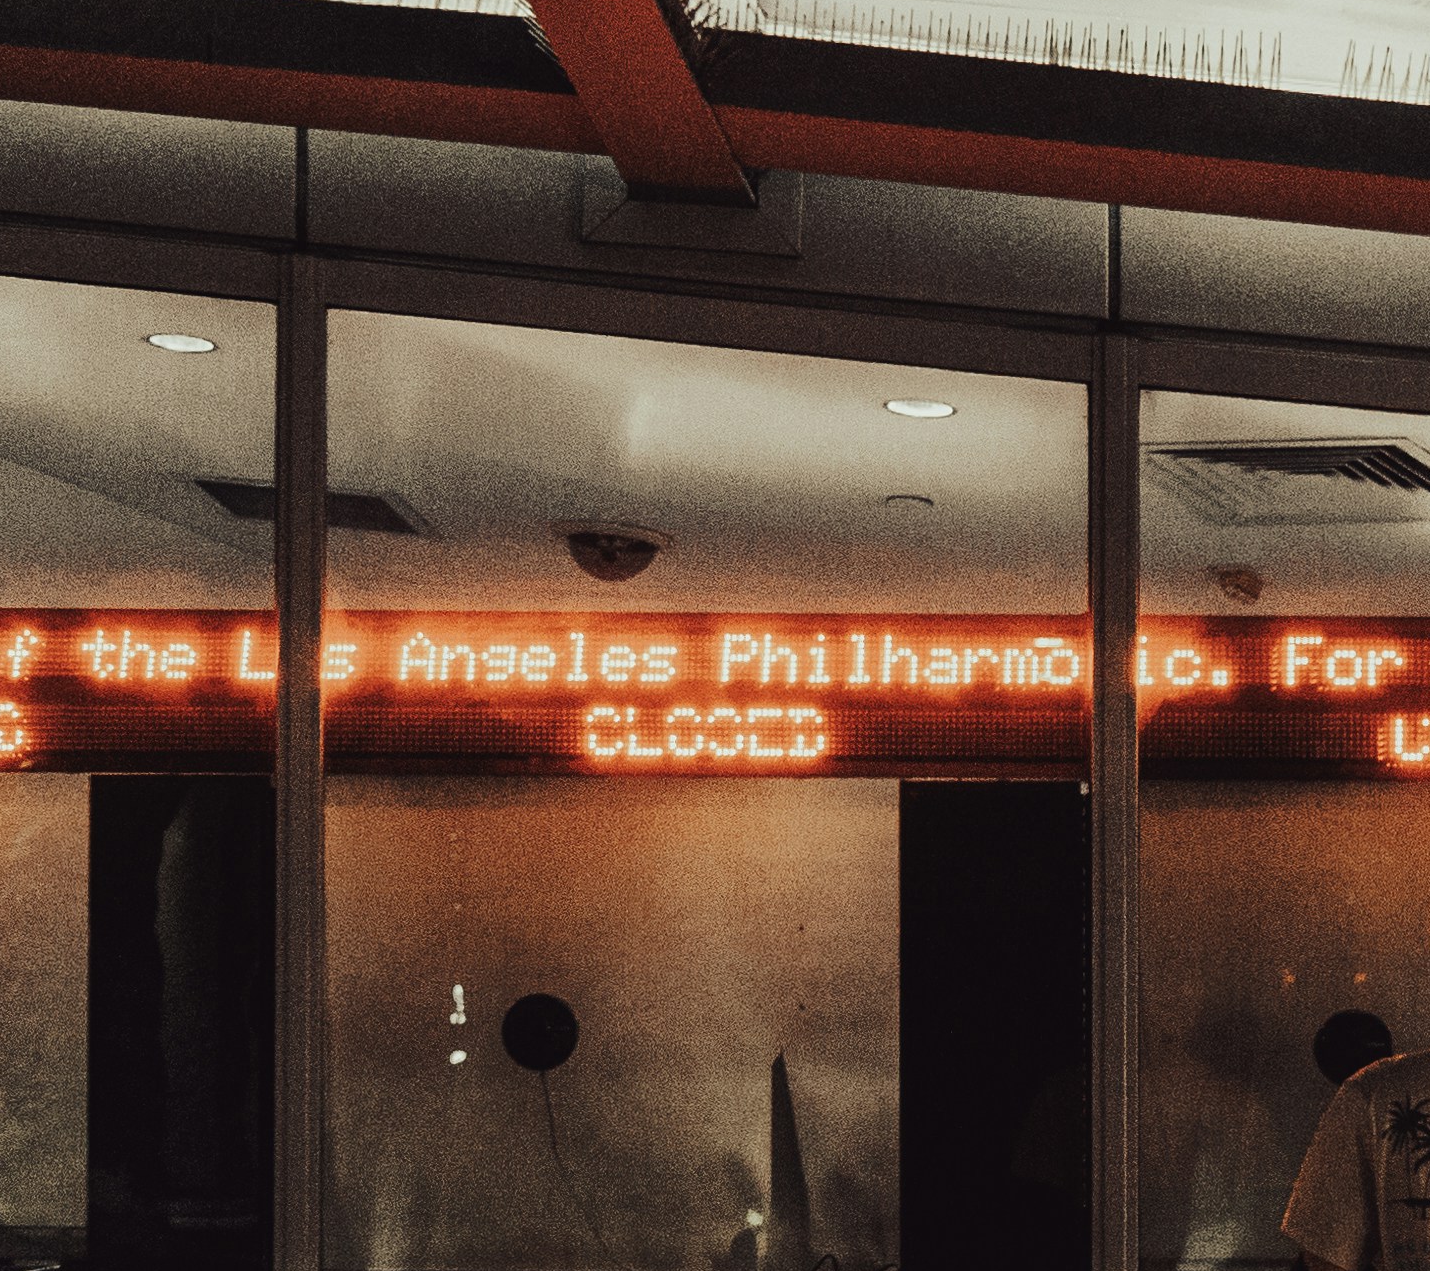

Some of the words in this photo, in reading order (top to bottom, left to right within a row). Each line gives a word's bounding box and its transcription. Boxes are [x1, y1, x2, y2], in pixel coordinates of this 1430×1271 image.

[80, 629, 198, 679] the
[239, 630, 358, 680] Ls
[399, 631, 678, 682] Angeles
[1286, 636, 1404, 686] For
